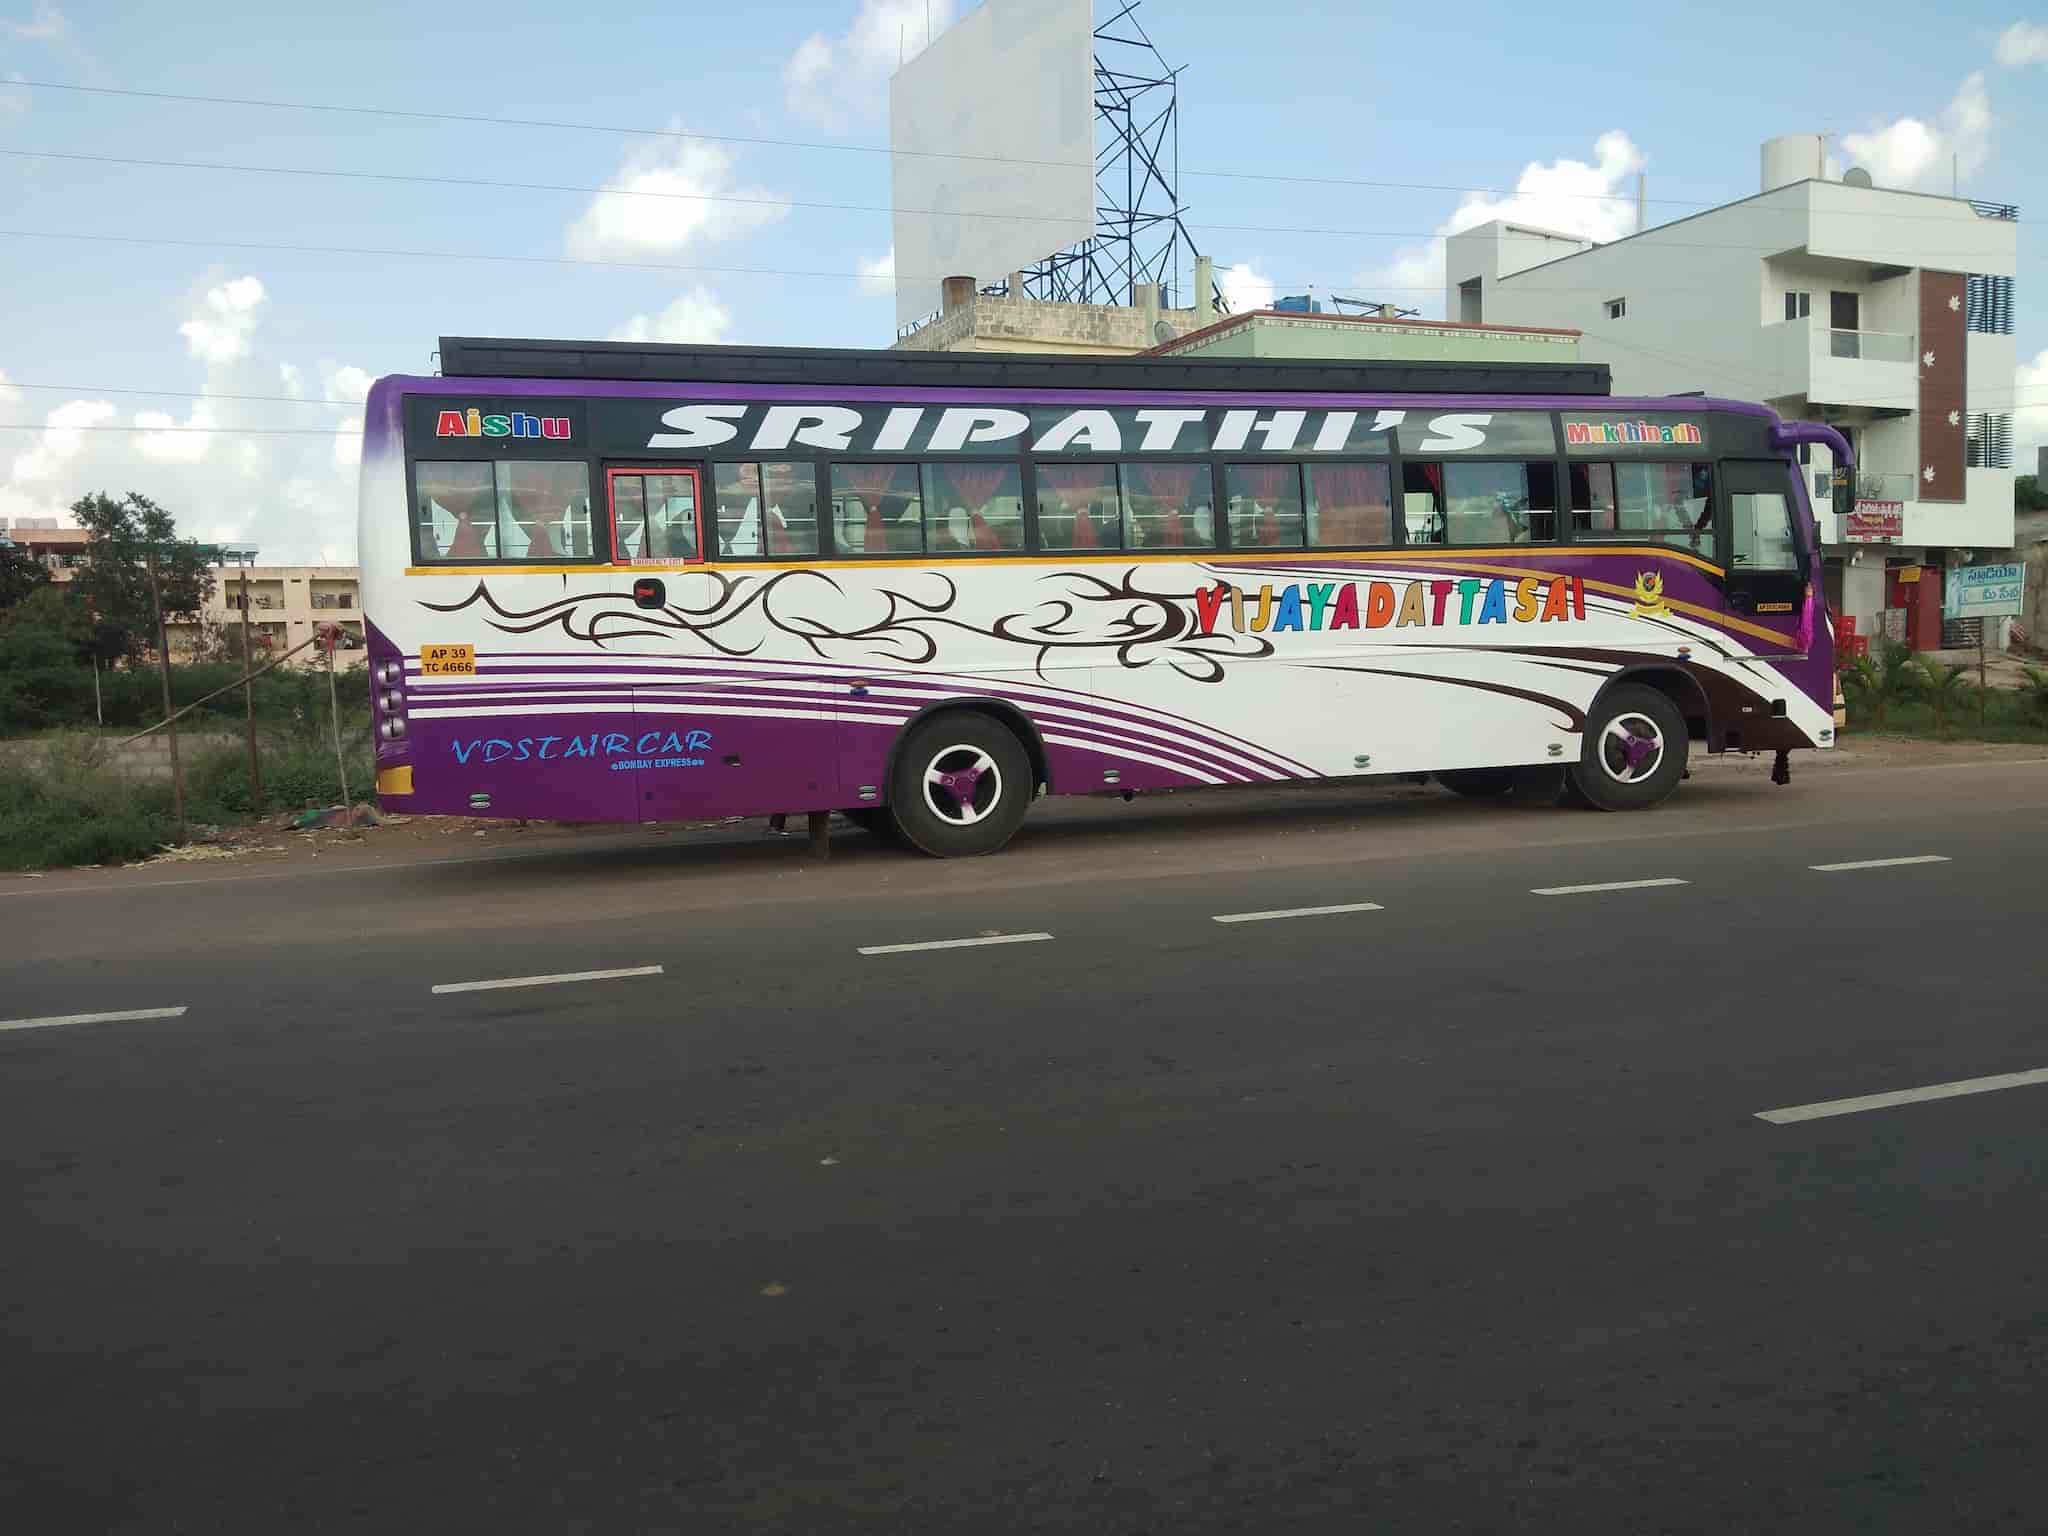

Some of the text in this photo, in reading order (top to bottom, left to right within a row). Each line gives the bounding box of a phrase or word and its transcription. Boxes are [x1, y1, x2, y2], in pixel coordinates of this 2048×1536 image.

[436, 408, 571, 439] Aishu
[646, 405, 1493, 451] SRIPATHI'S
[1566, 420, 1702, 444] Mukthinadh
[1195, 576, 1586, 634] VIJAYADATTASAI
[431, 648, 466, 659] AP 39
[424, 662, 473, 673] TC 4666
[617, 758, 653, 770] BOMBAY
